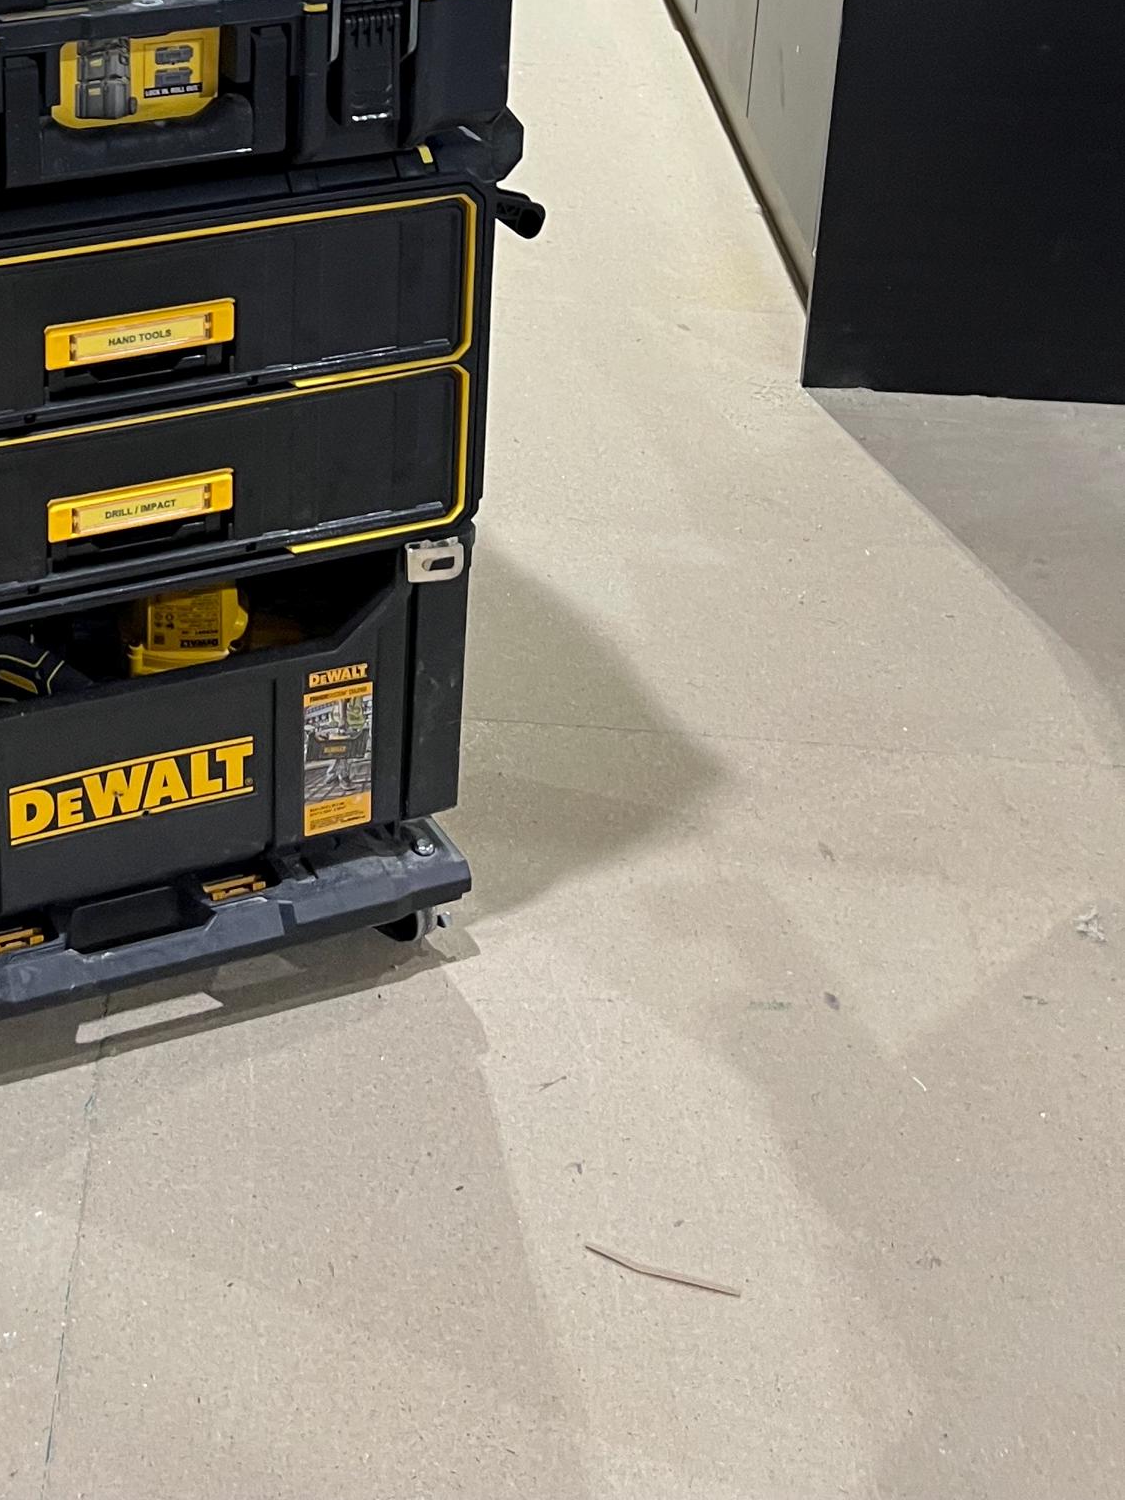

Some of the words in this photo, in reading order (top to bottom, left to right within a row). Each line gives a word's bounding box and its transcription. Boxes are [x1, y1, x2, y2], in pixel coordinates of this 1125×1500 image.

[108, 334, 136, 347] HAND
[139, 329, 172, 343] TOOLS
[105, 507, 133, 520] DRILL
[140, 499, 177, 514] IMPACT
